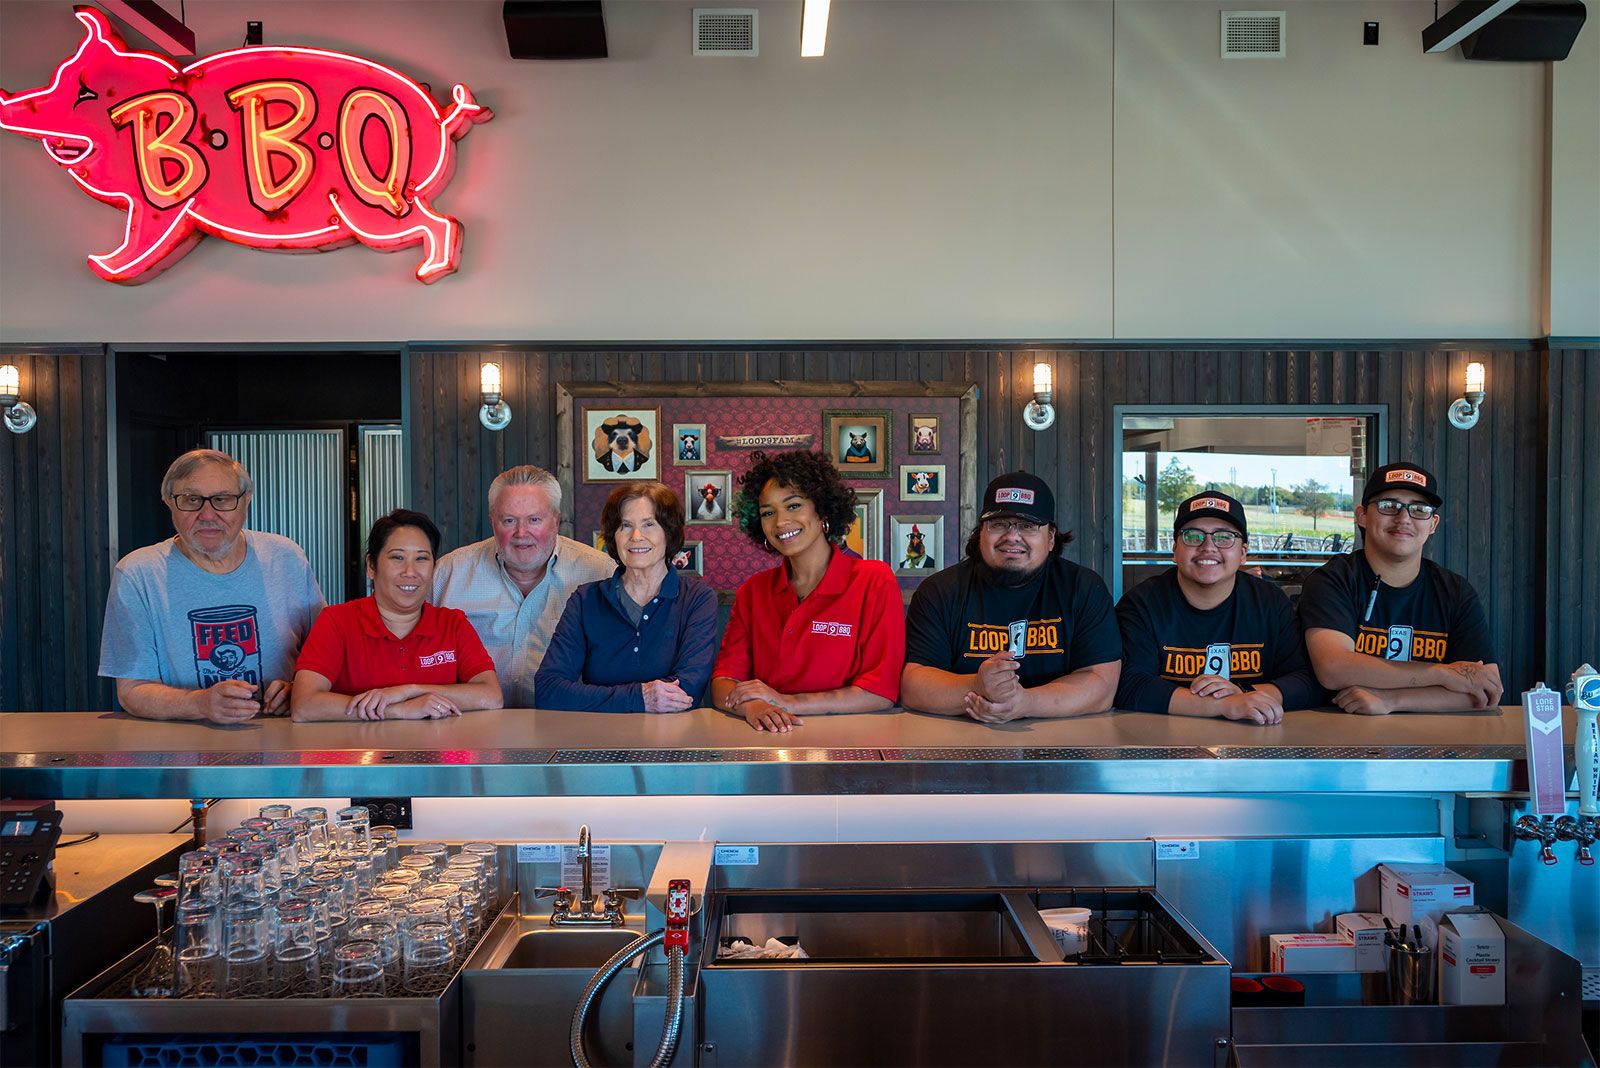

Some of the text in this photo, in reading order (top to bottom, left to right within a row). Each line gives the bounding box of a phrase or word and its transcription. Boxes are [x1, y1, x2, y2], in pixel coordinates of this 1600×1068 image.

[736, 437, 794, 445] #LOOP9FAM
[199, 621, 252, 646] FEED
[812, 623, 851, 635] LOOP 9 BBQ
[969, 630, 1009, 651] LOOP
[1027, 625, 1058, 648] BBQ
[1355, 632, 1447, 662] OOP 9 BBQ
[437, 655, 444, 665] 9
[1165, 650, 1261, 676] LOOP 9 BBQ
